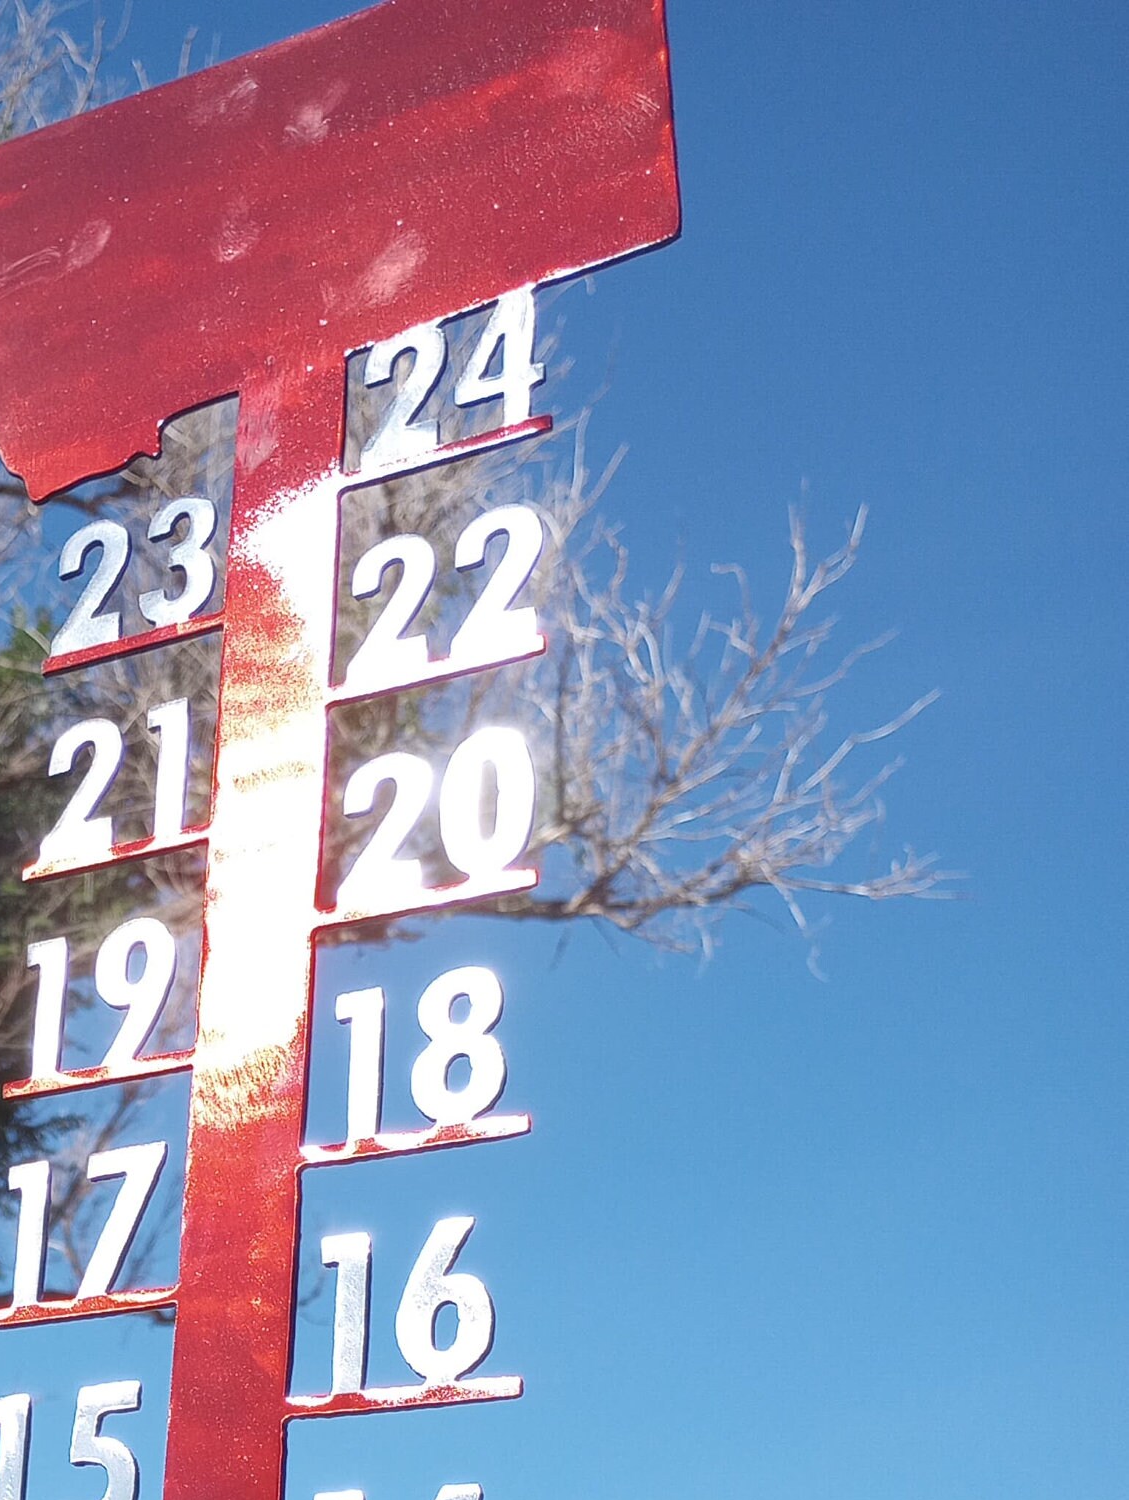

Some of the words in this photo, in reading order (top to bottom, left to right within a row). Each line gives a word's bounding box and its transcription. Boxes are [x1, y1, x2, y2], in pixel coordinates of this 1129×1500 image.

[361, 286, 545, 468] 24
[49, 498, 217, 657] 23
[343, 504, 545, 690] 22
[39, 697, 189, 860] 21
[334, 726, 536, 908] 20
[27, 917, 177, 1083] 19
[334, 966, 507, 1145] 18
[8, 1141, 168, 1311] 17
[320, 1216, 496, 1395] 16
